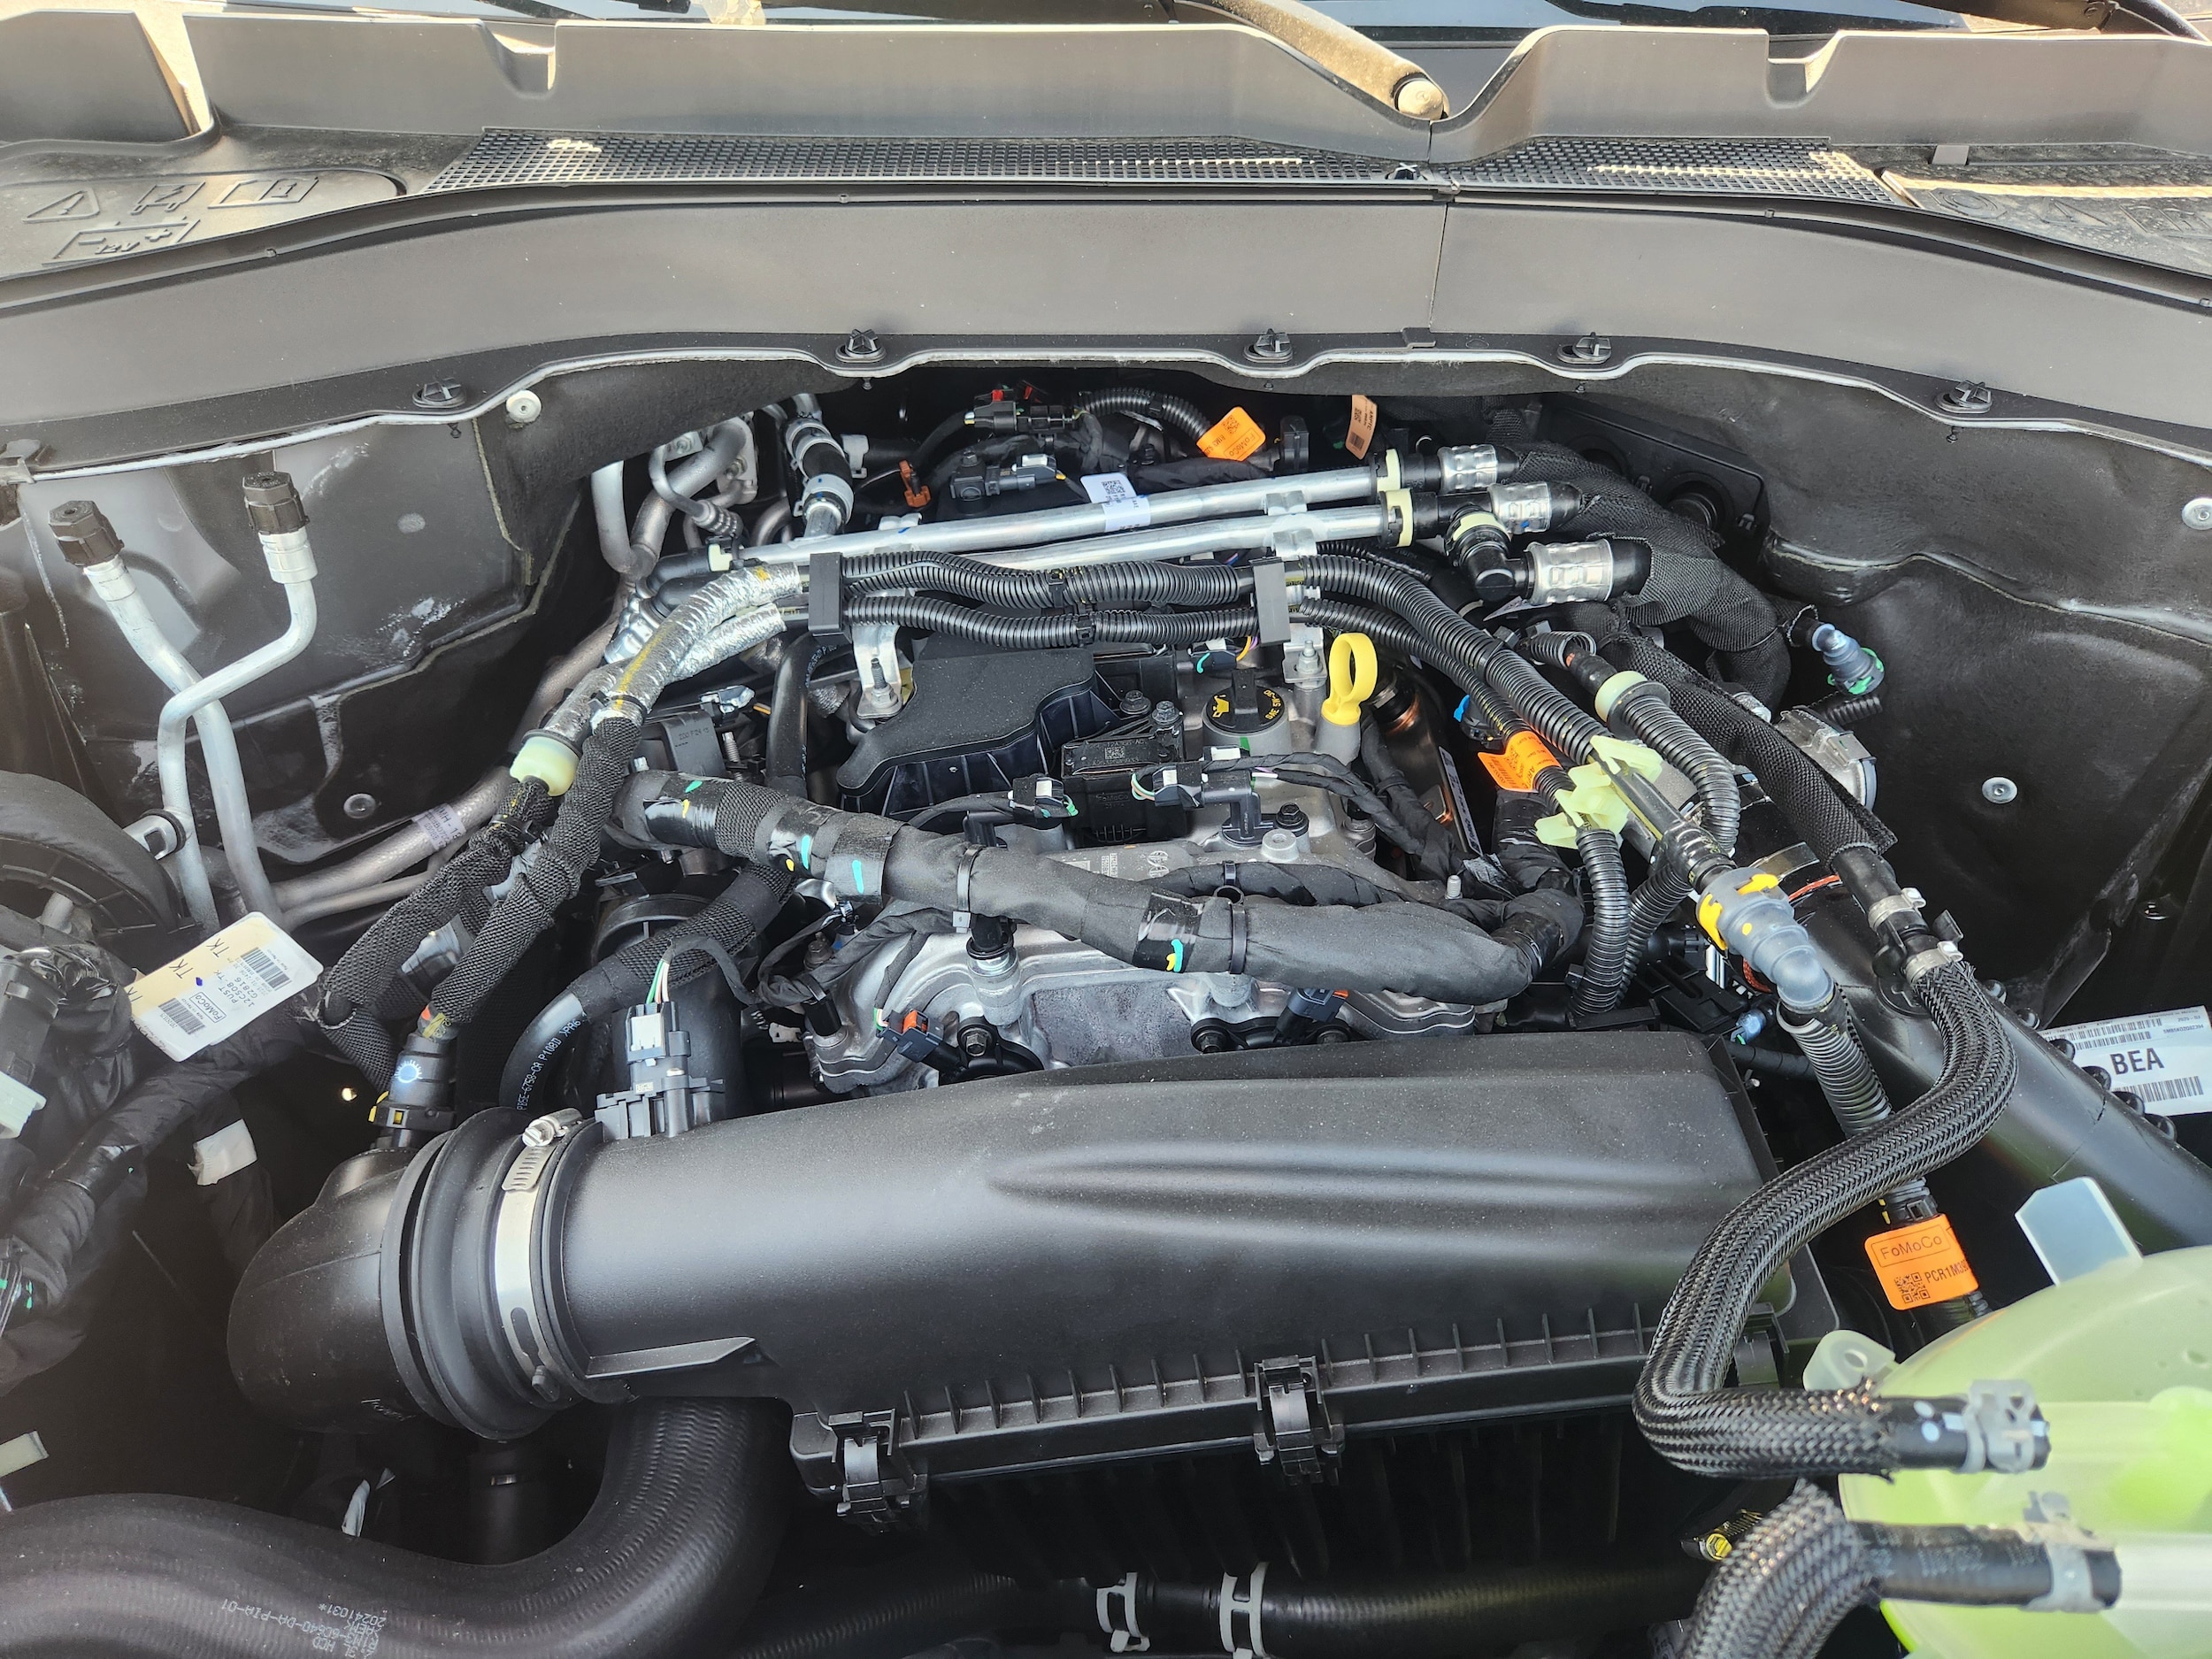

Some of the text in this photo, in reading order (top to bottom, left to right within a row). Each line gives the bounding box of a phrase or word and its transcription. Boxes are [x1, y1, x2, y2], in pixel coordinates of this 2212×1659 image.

[95, 242, 140, 255] 12V
[1229, 433, 1256, 457] FoMoCo
[1265, 708, 1280, 720] SAE
[206, 938, 230, 958] TK
[169, 958, 194, 979] TK
[212, 969, 256, 1008] 12C508-TK
[234, 977, 258, 999] G2816
[195, 995, 221, 1021] FoMoCo
[2109, 1047, 2164, 1075] BEA
[1880, 1235, 1942, 1259] FoMoCo
